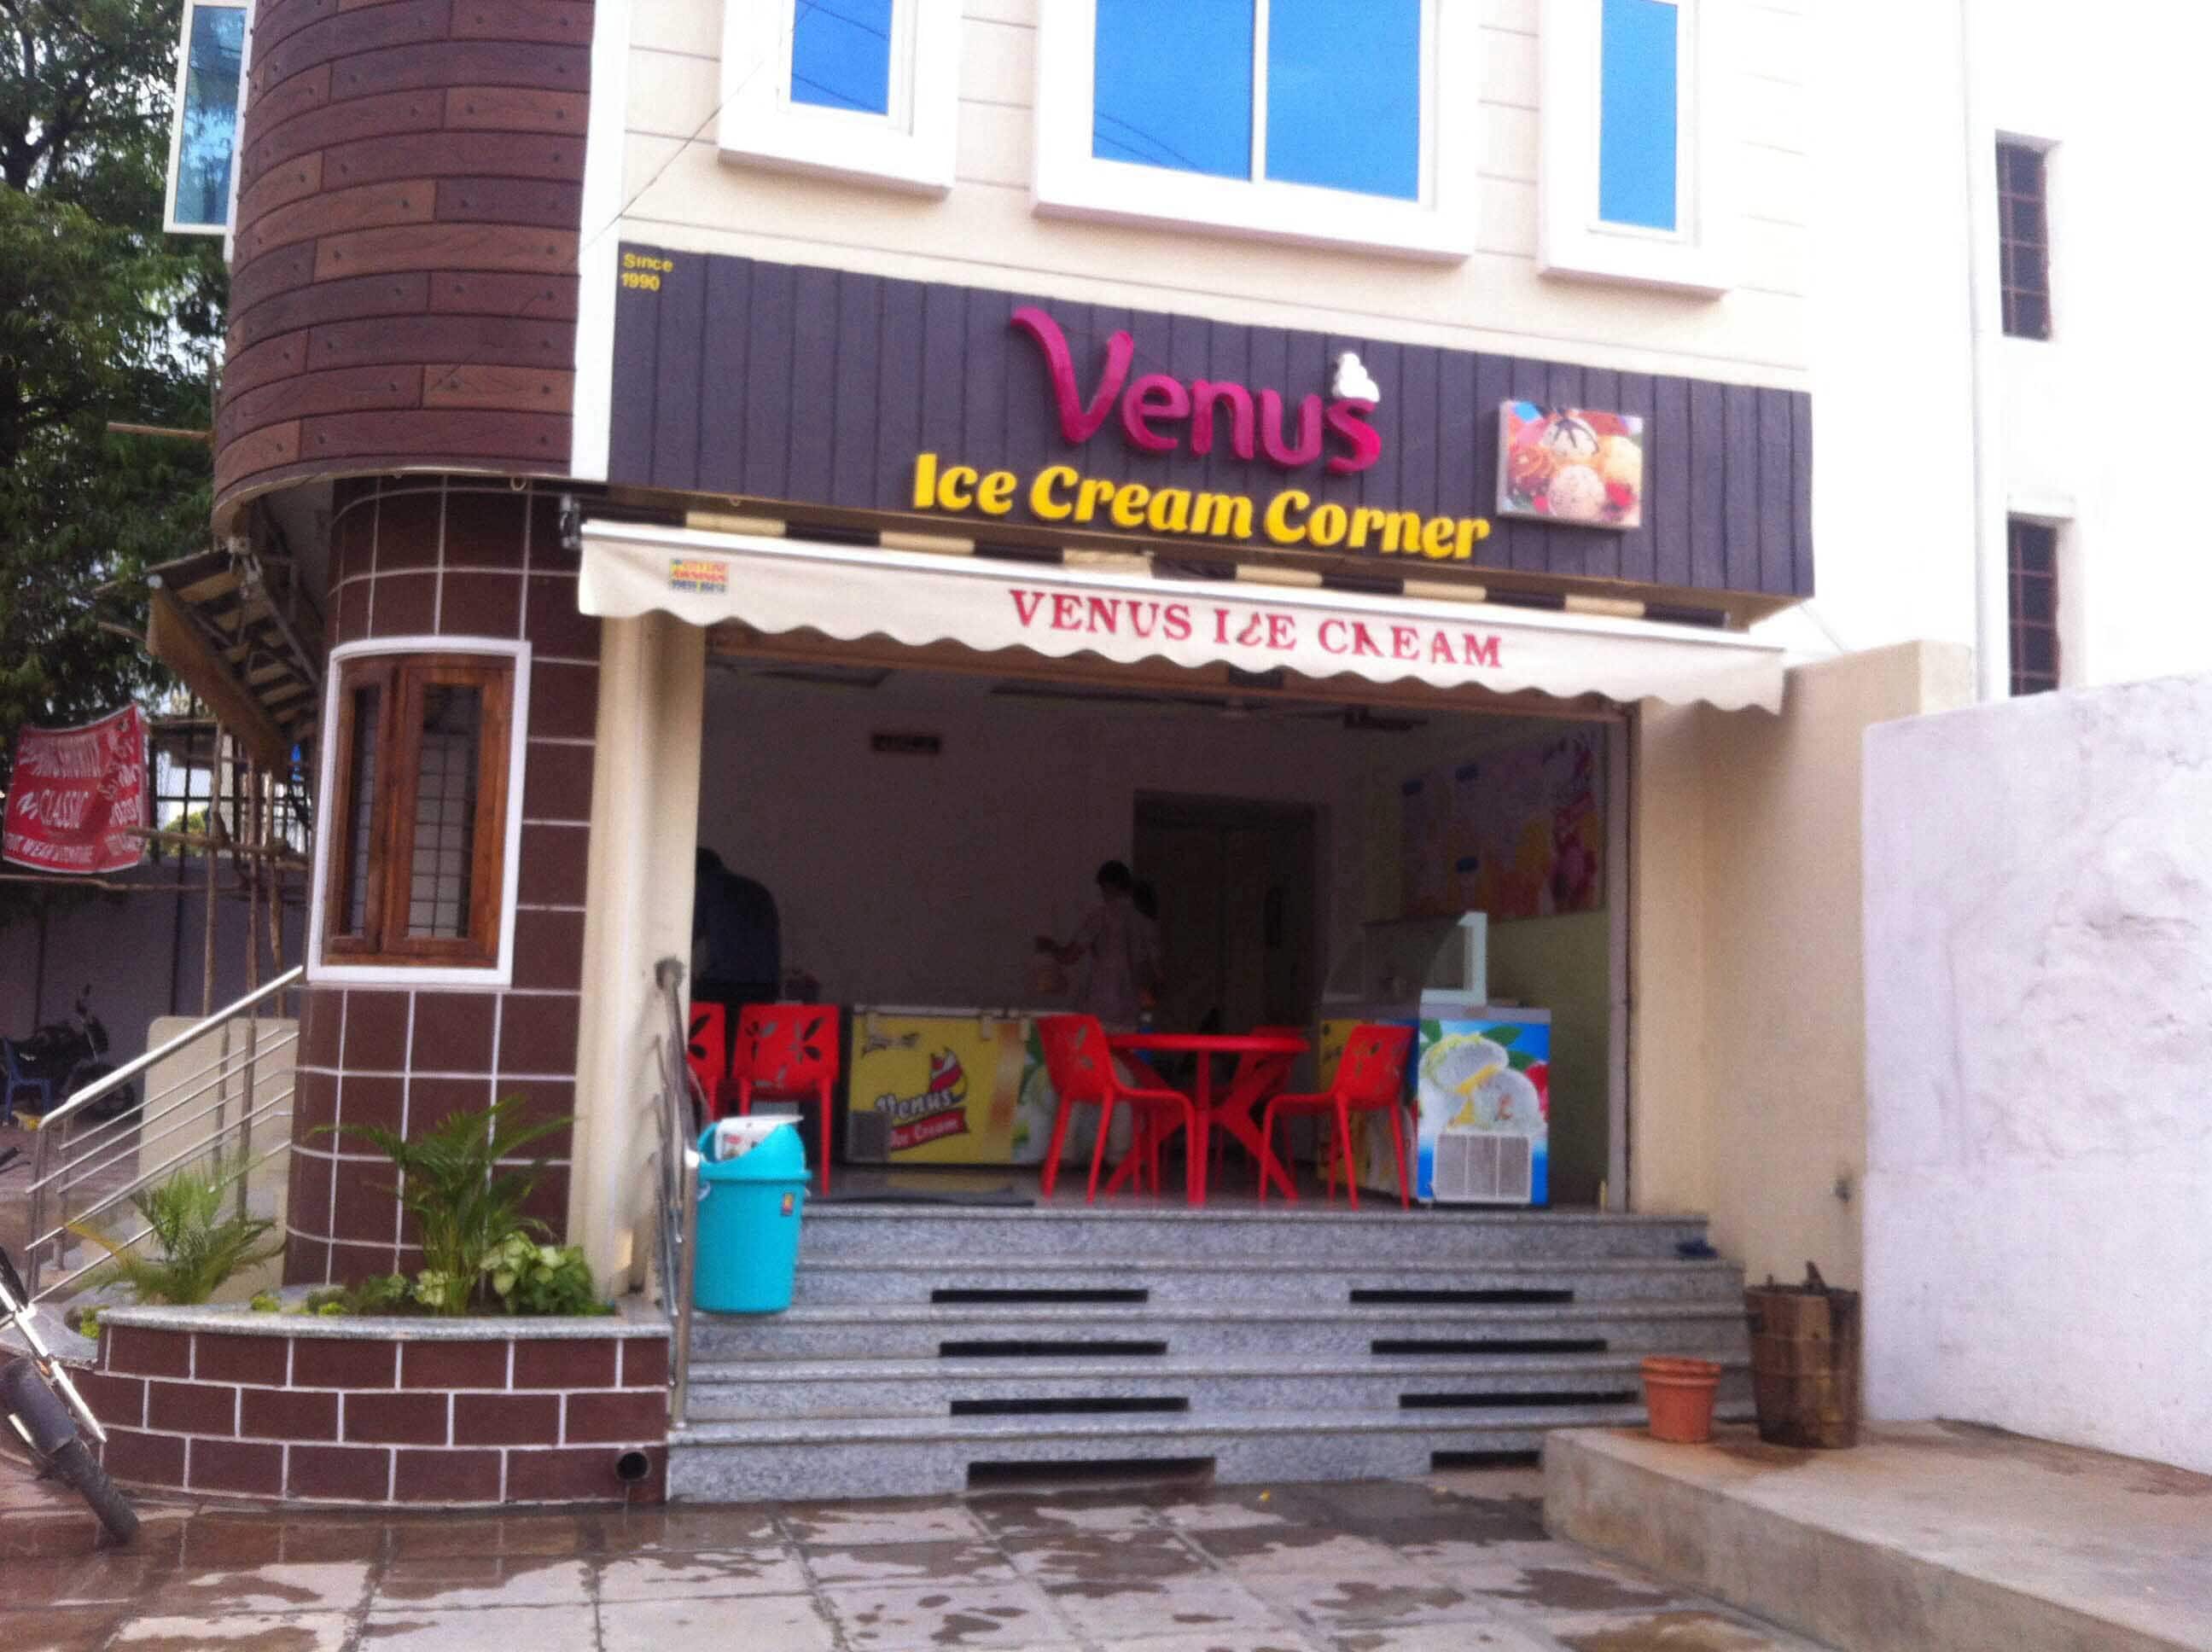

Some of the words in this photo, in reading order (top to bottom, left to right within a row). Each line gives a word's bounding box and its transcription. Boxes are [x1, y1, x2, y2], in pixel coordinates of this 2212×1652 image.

[621, 271, 661, 292] 1990
[622, 253, 674, 273] Since
[1010, 306, 1382, 475] Venus
[913, 452, 1016, 515] Ice
[1029, 465, 1253, 539] Cream
[1264, 490, 1491, 560] Corner
[1008, 589, 1193, 641] VENUS
